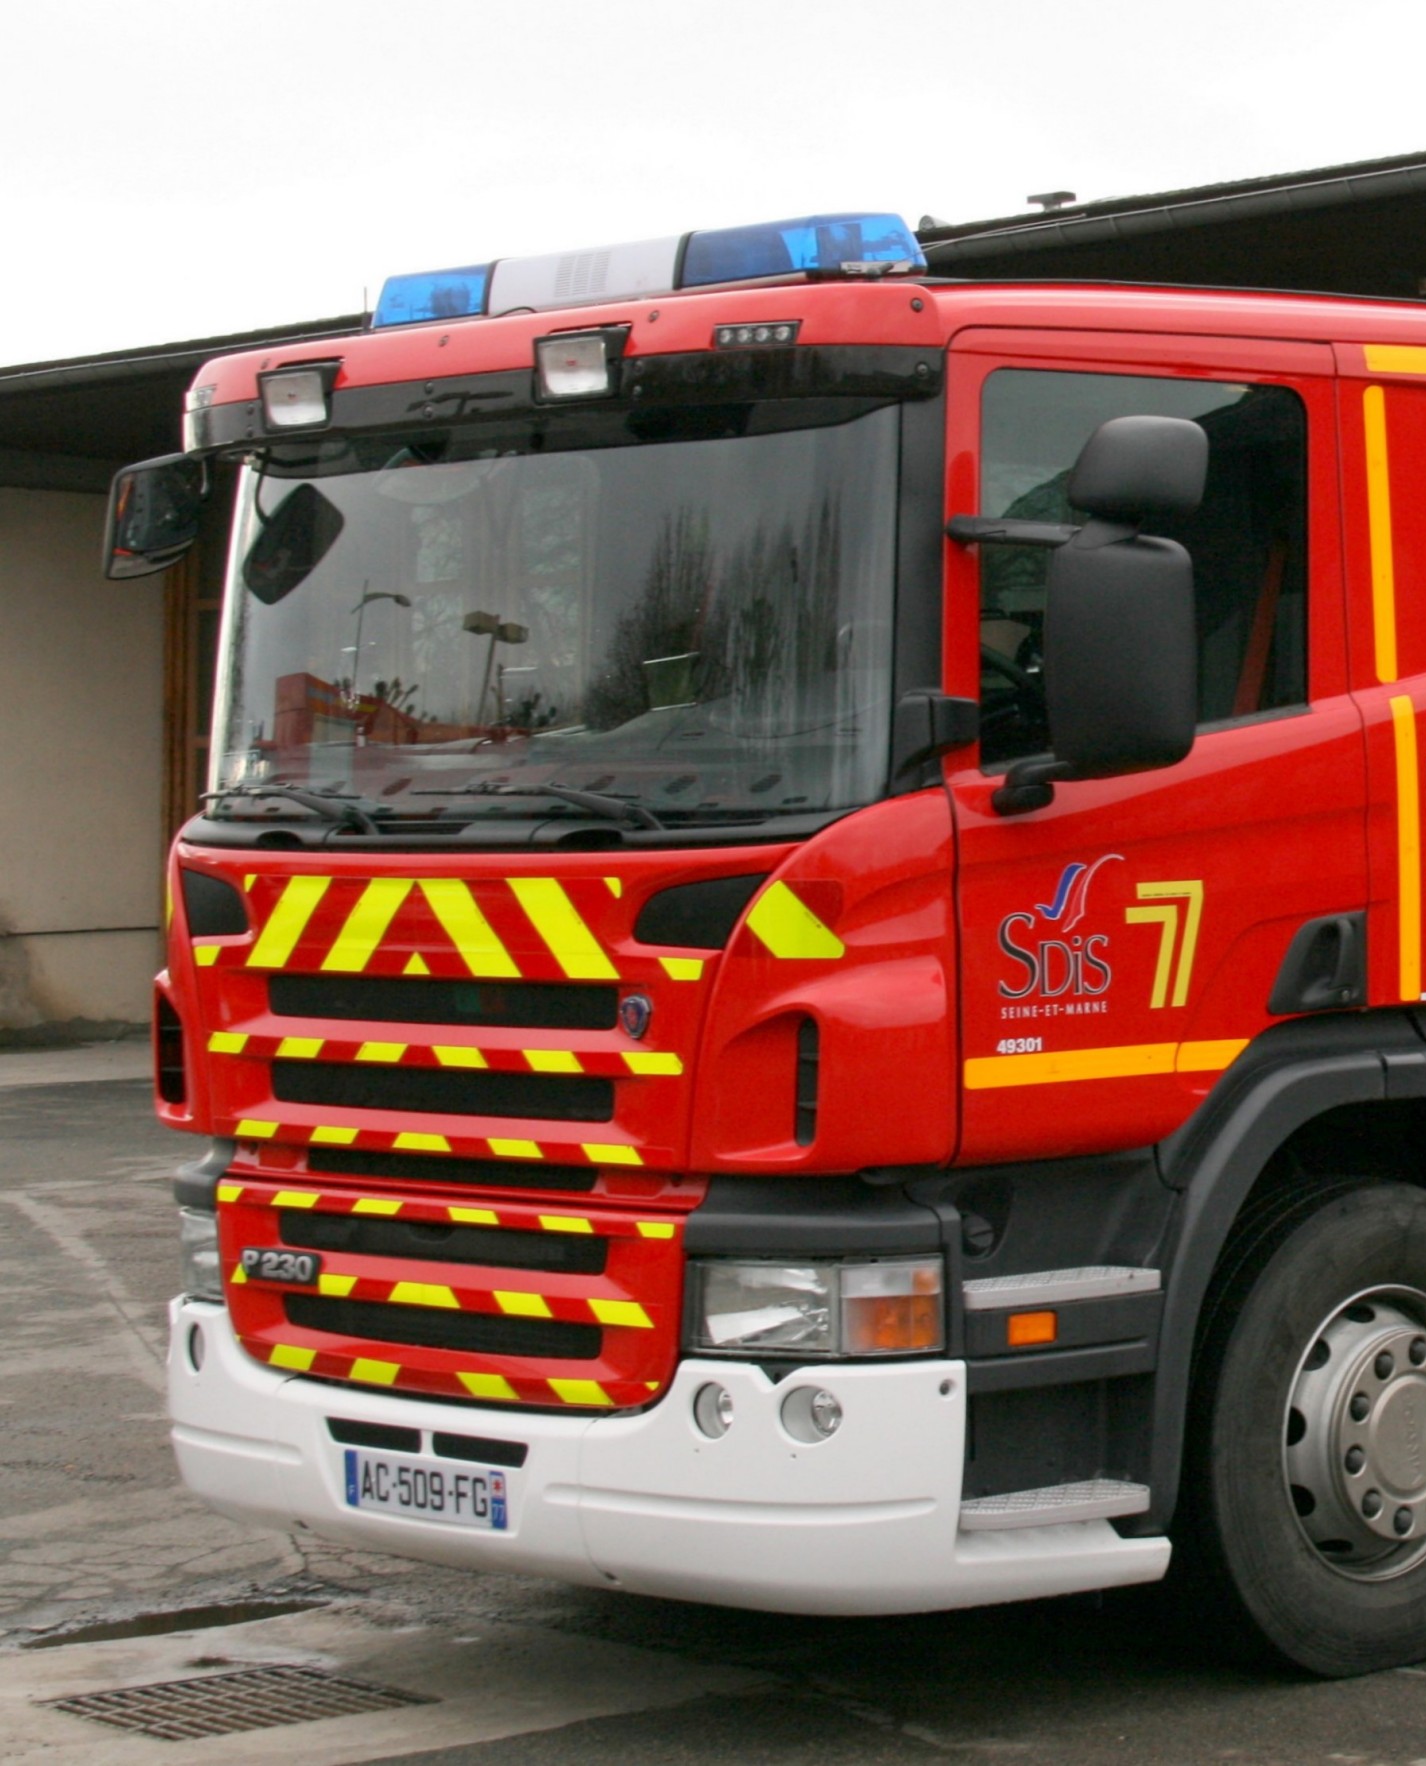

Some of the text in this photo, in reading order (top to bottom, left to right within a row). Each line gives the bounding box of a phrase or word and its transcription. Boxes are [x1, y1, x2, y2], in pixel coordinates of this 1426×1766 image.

[1125, 879, 1204, 1009] 77
[1001, 1000, 1108, 1019] SEINE-ET-MARNE
[997, 1036, 1043, 1054] 49301
[242, 1249, 313, 1281] P 230
[361, 1460, 488, 1518] AC-509-FG
